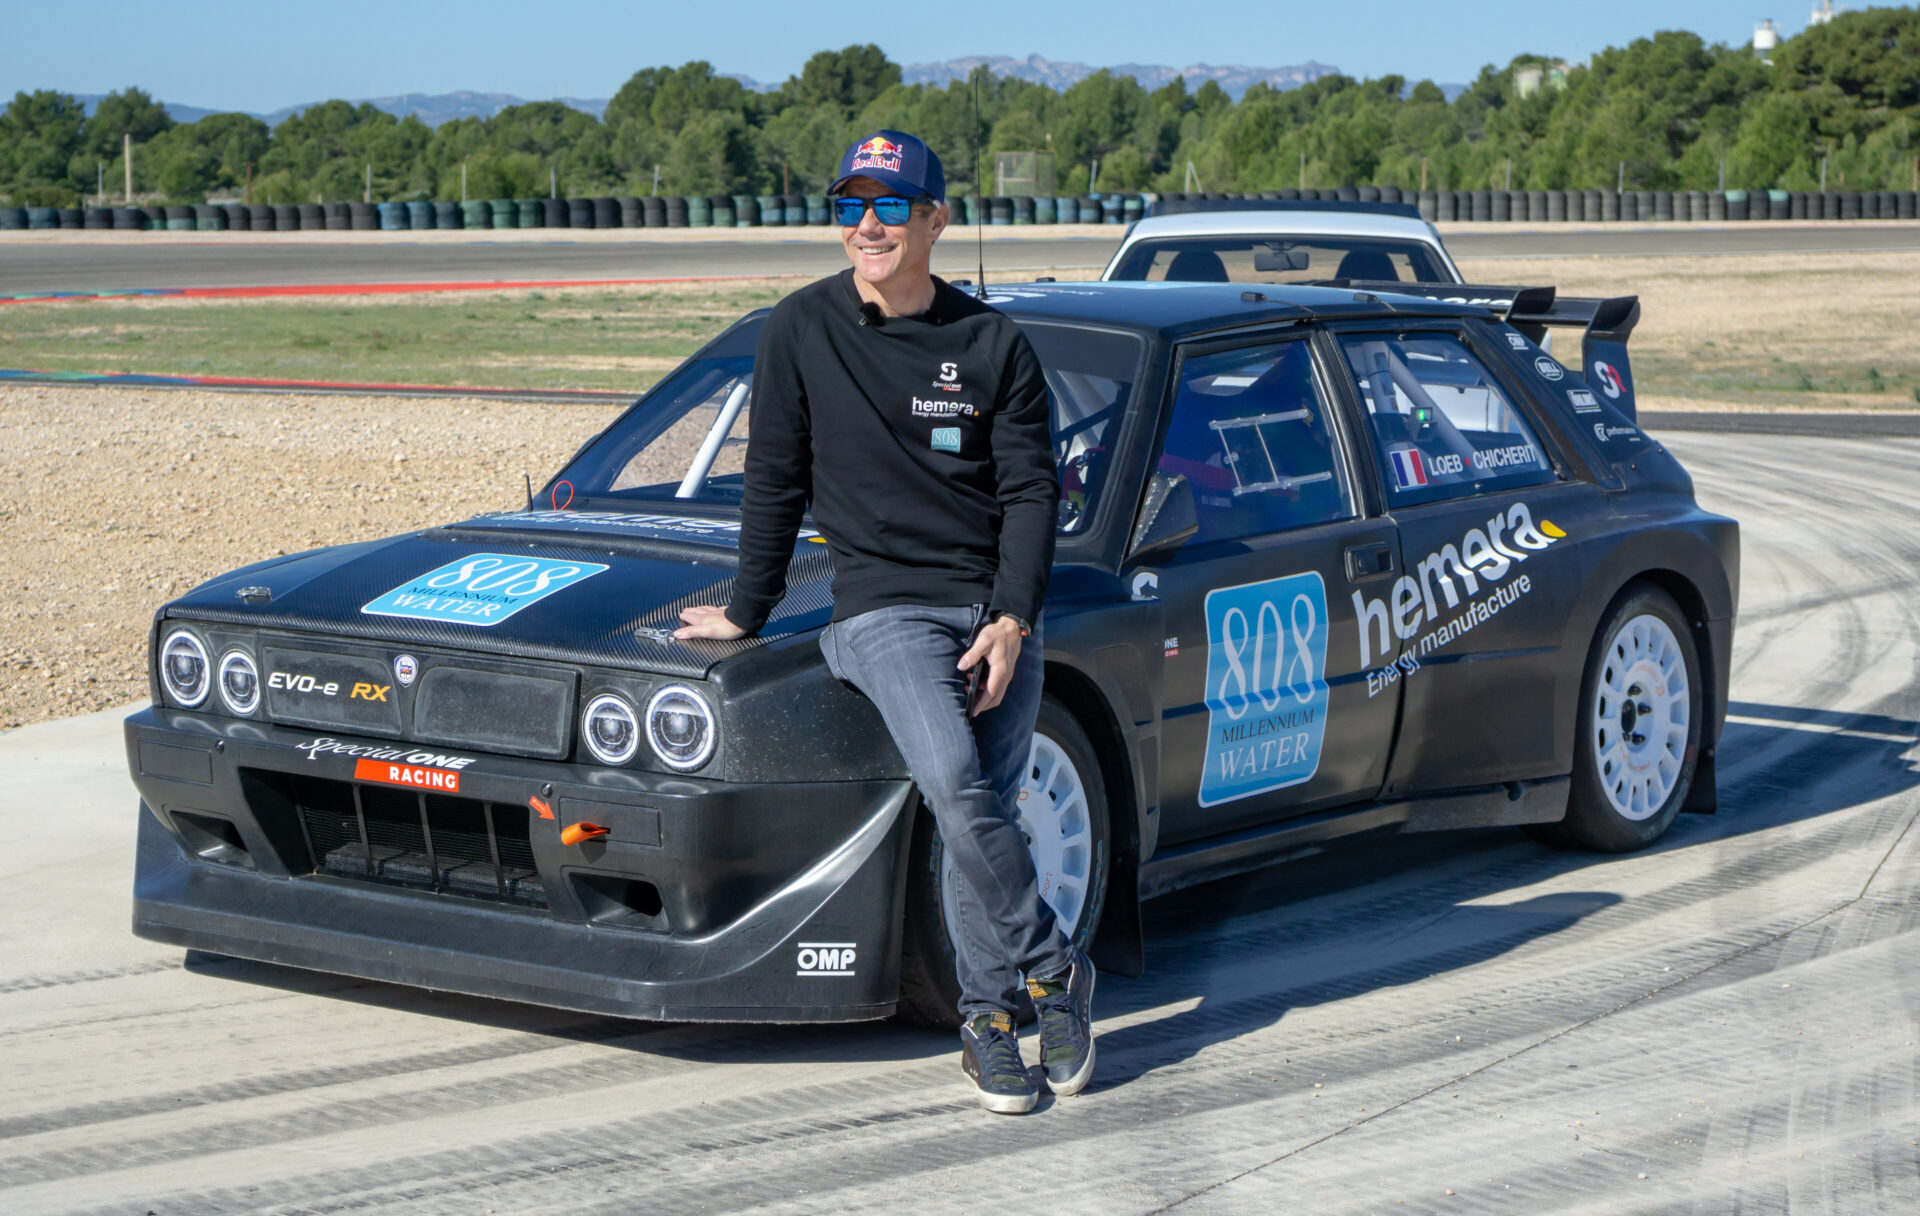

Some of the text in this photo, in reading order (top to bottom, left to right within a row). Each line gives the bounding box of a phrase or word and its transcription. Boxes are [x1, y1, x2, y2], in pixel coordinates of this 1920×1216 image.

[851, 155, 900, 172] Red Bull
[934, 430, 957, 446] 808
[1428, 444, 1535, 476] LOEB CHICHERIT
[426, 558, 580, 596] 808
[392, 594, 502, 617] WATER
[408, 586, 519, 605] MILLENNIUM
[1366, 574, 1531, 698] Energy manufacture
[1218, 593, 1316, 720] 808
[268, 672, 391, 702] EVO-e RX
[1221, 708, 1315, 744] MILLENNIUM
[1219, 732, 1310, 782] WATER
[389, 766, 456, 788] RACING
[797, 948, 856, 970] OMP
